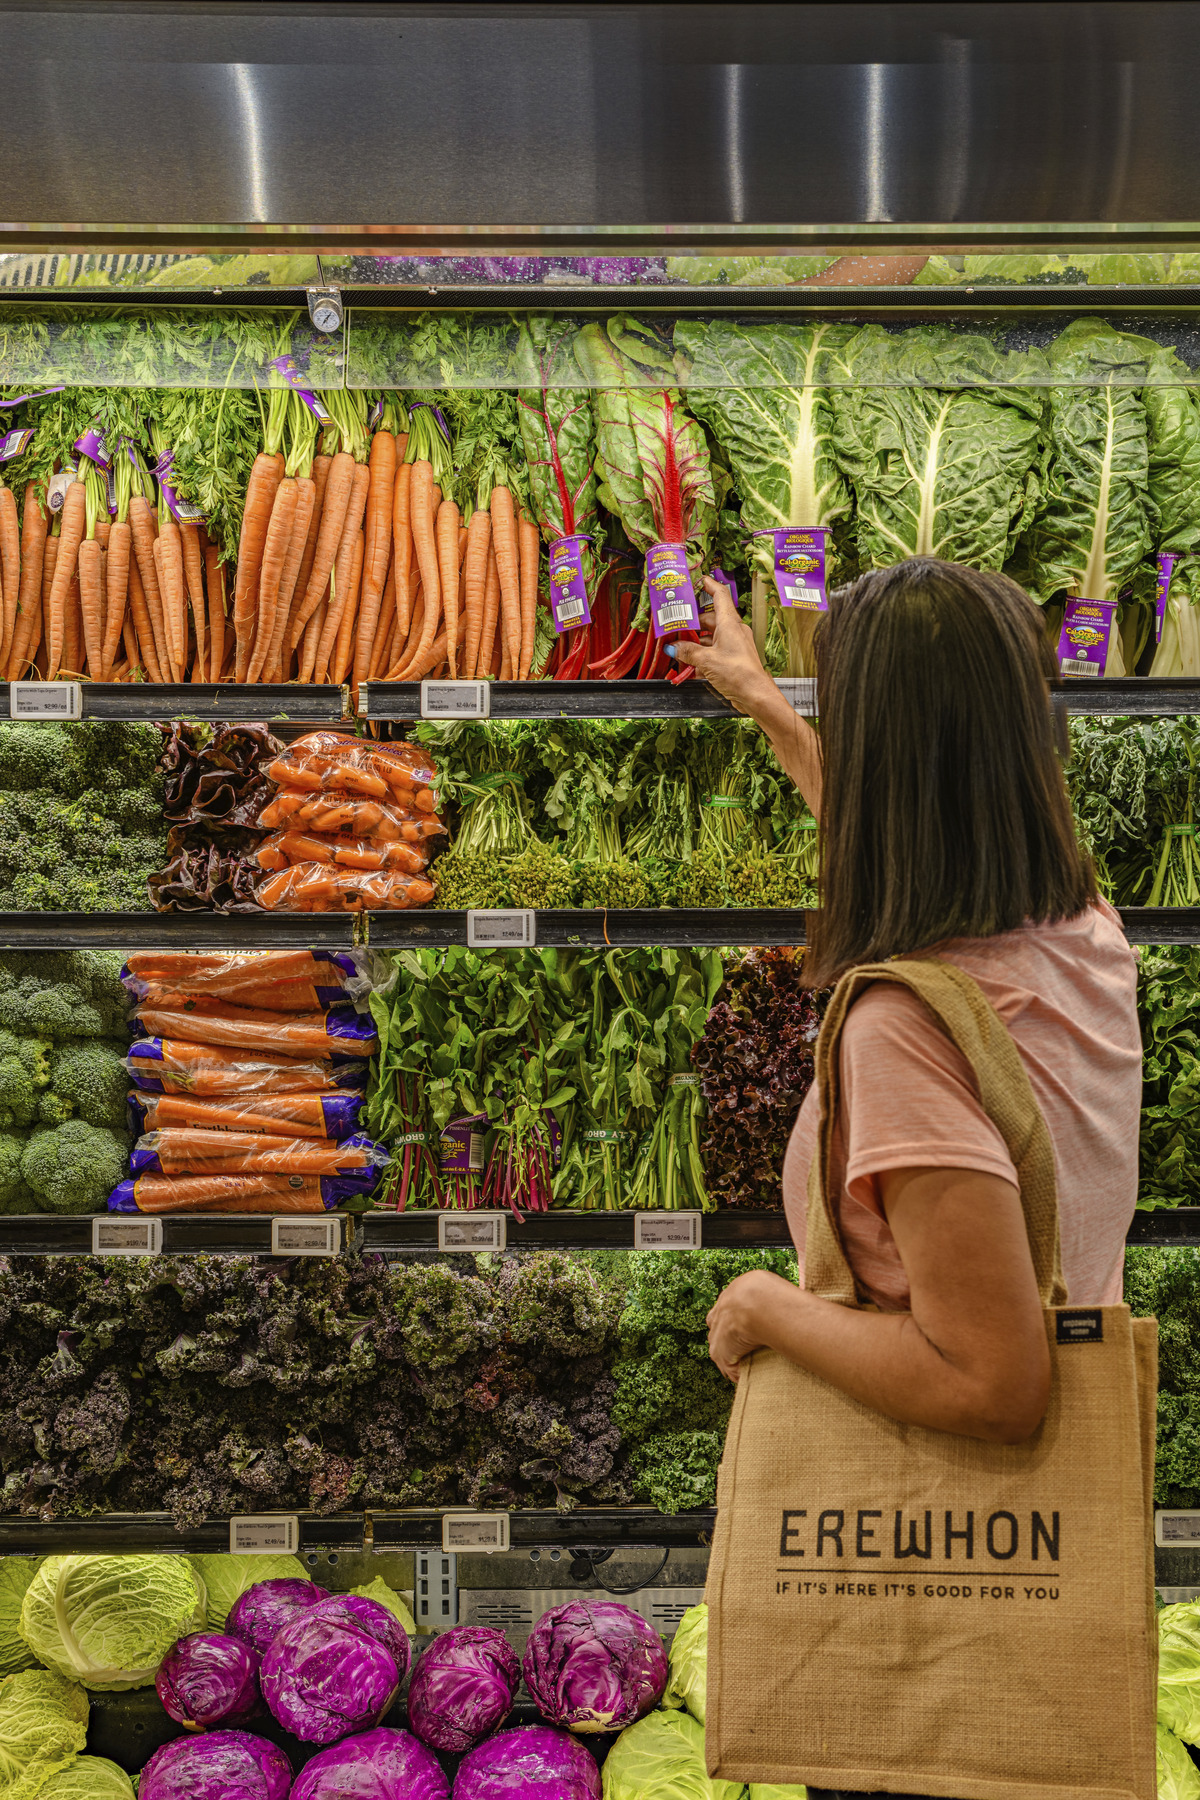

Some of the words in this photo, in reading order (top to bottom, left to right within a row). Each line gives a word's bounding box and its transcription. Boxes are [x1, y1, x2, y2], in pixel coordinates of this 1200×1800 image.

[395, 1133, 425, 1145] GROWN
[780, 1510, 1059, 1561] EREWHON
[776, 1582, 790, 1594] IF
[798, 1582, 827, 1595] IT'S
[835, 1583, 877, 1596] HERE
[885, 1584, 916, 1597] IT'S
[924, 1585, 972, 1598] GOOD
[980, 1586, 1014, 1599] FOR
[1024, 1587, 1059, 1600] YOU
